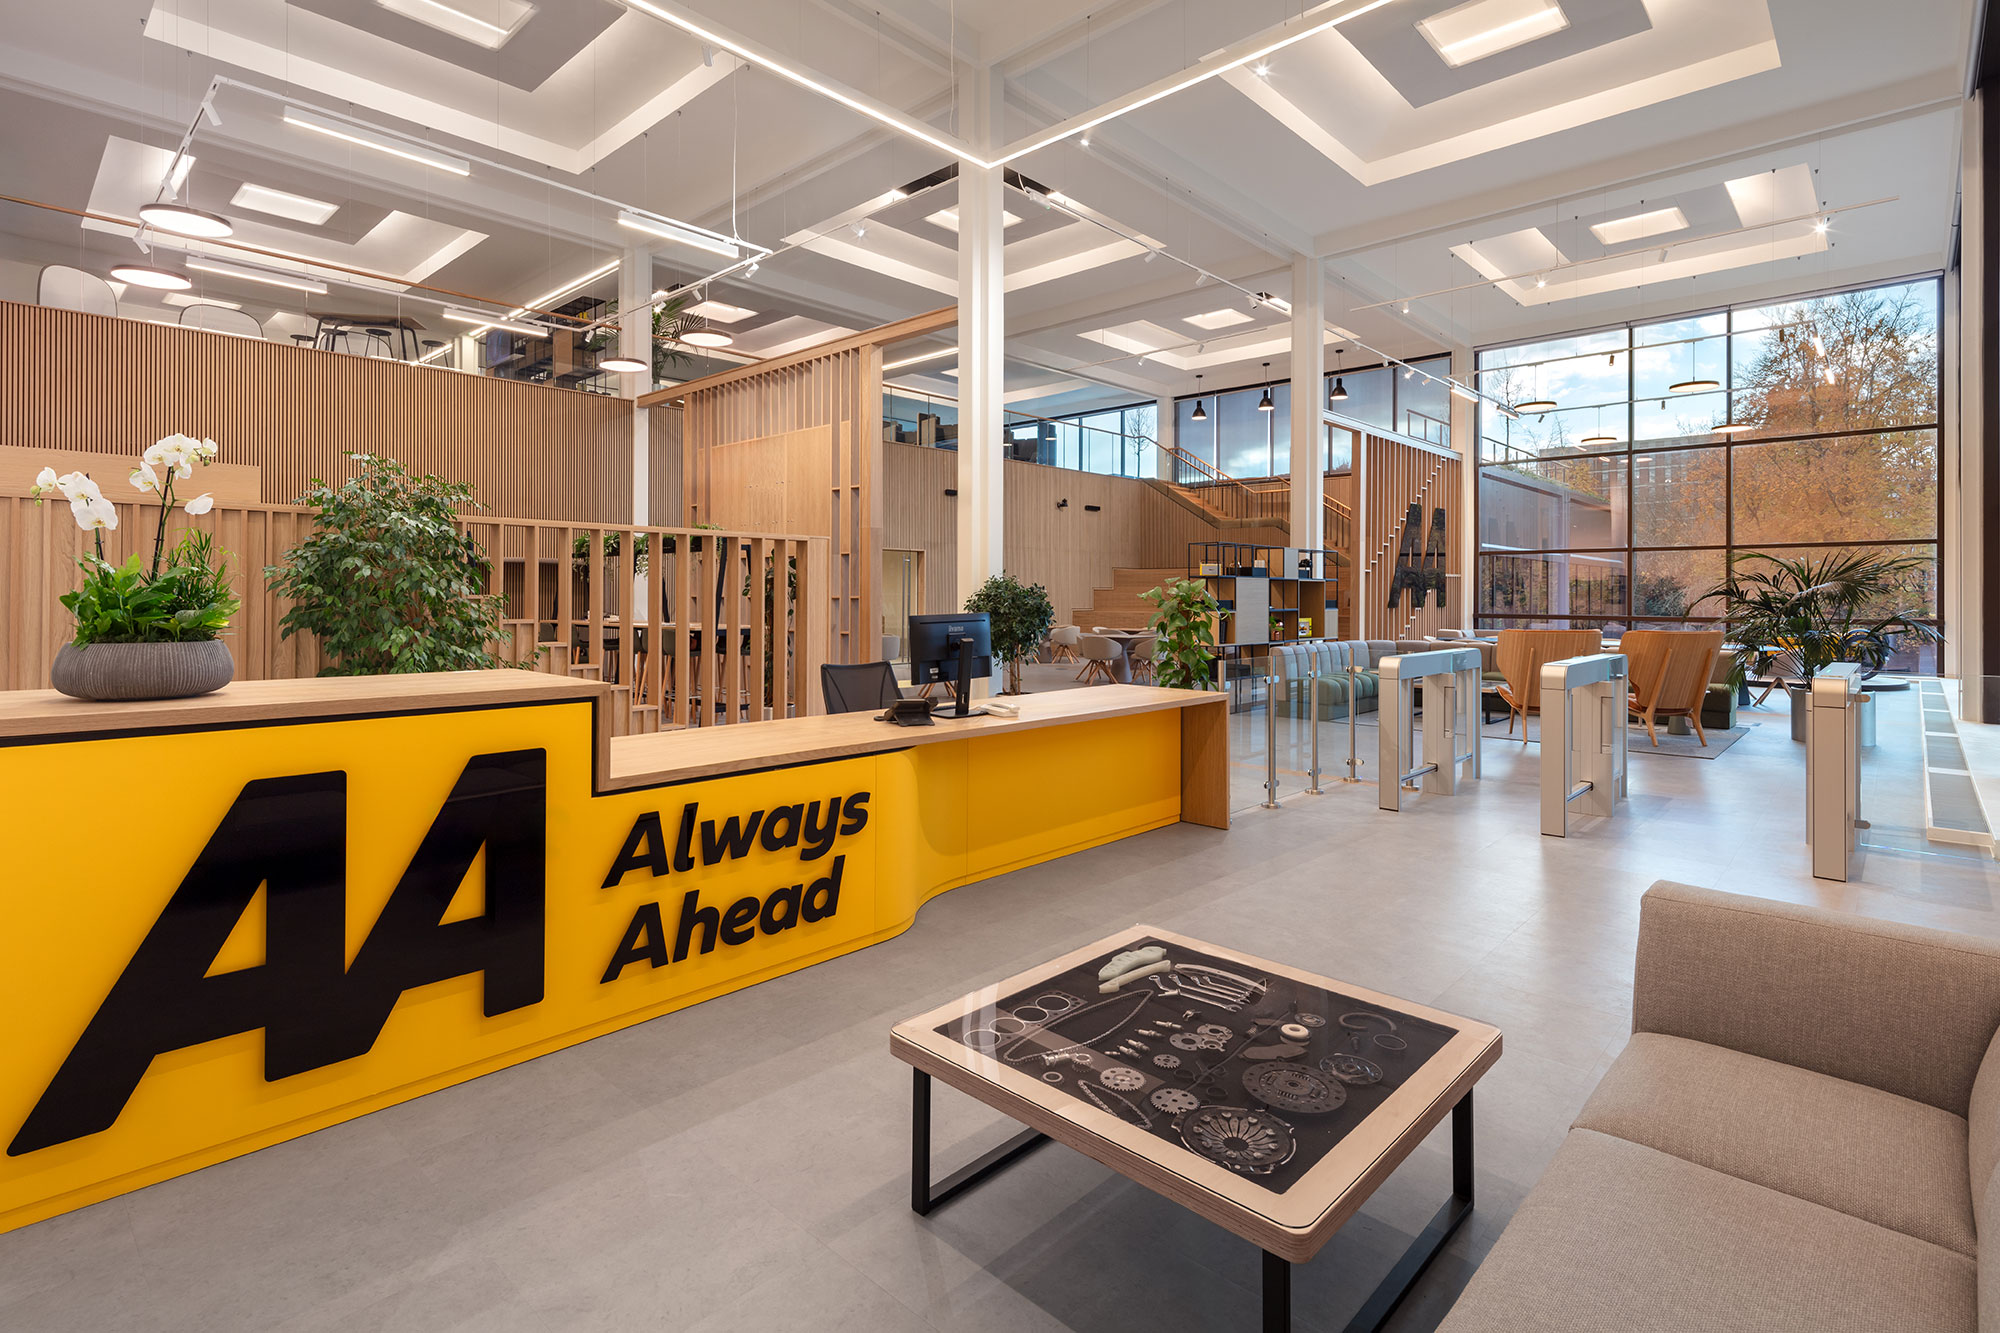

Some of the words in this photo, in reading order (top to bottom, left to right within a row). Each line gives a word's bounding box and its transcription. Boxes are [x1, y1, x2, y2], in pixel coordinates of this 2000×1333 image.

[1388, 504, 1446, 608] AA
[601, 792, 870, 889] Always
[7, 748, 546, 1157] AA
[600, 855, 845, 984] Ahead
